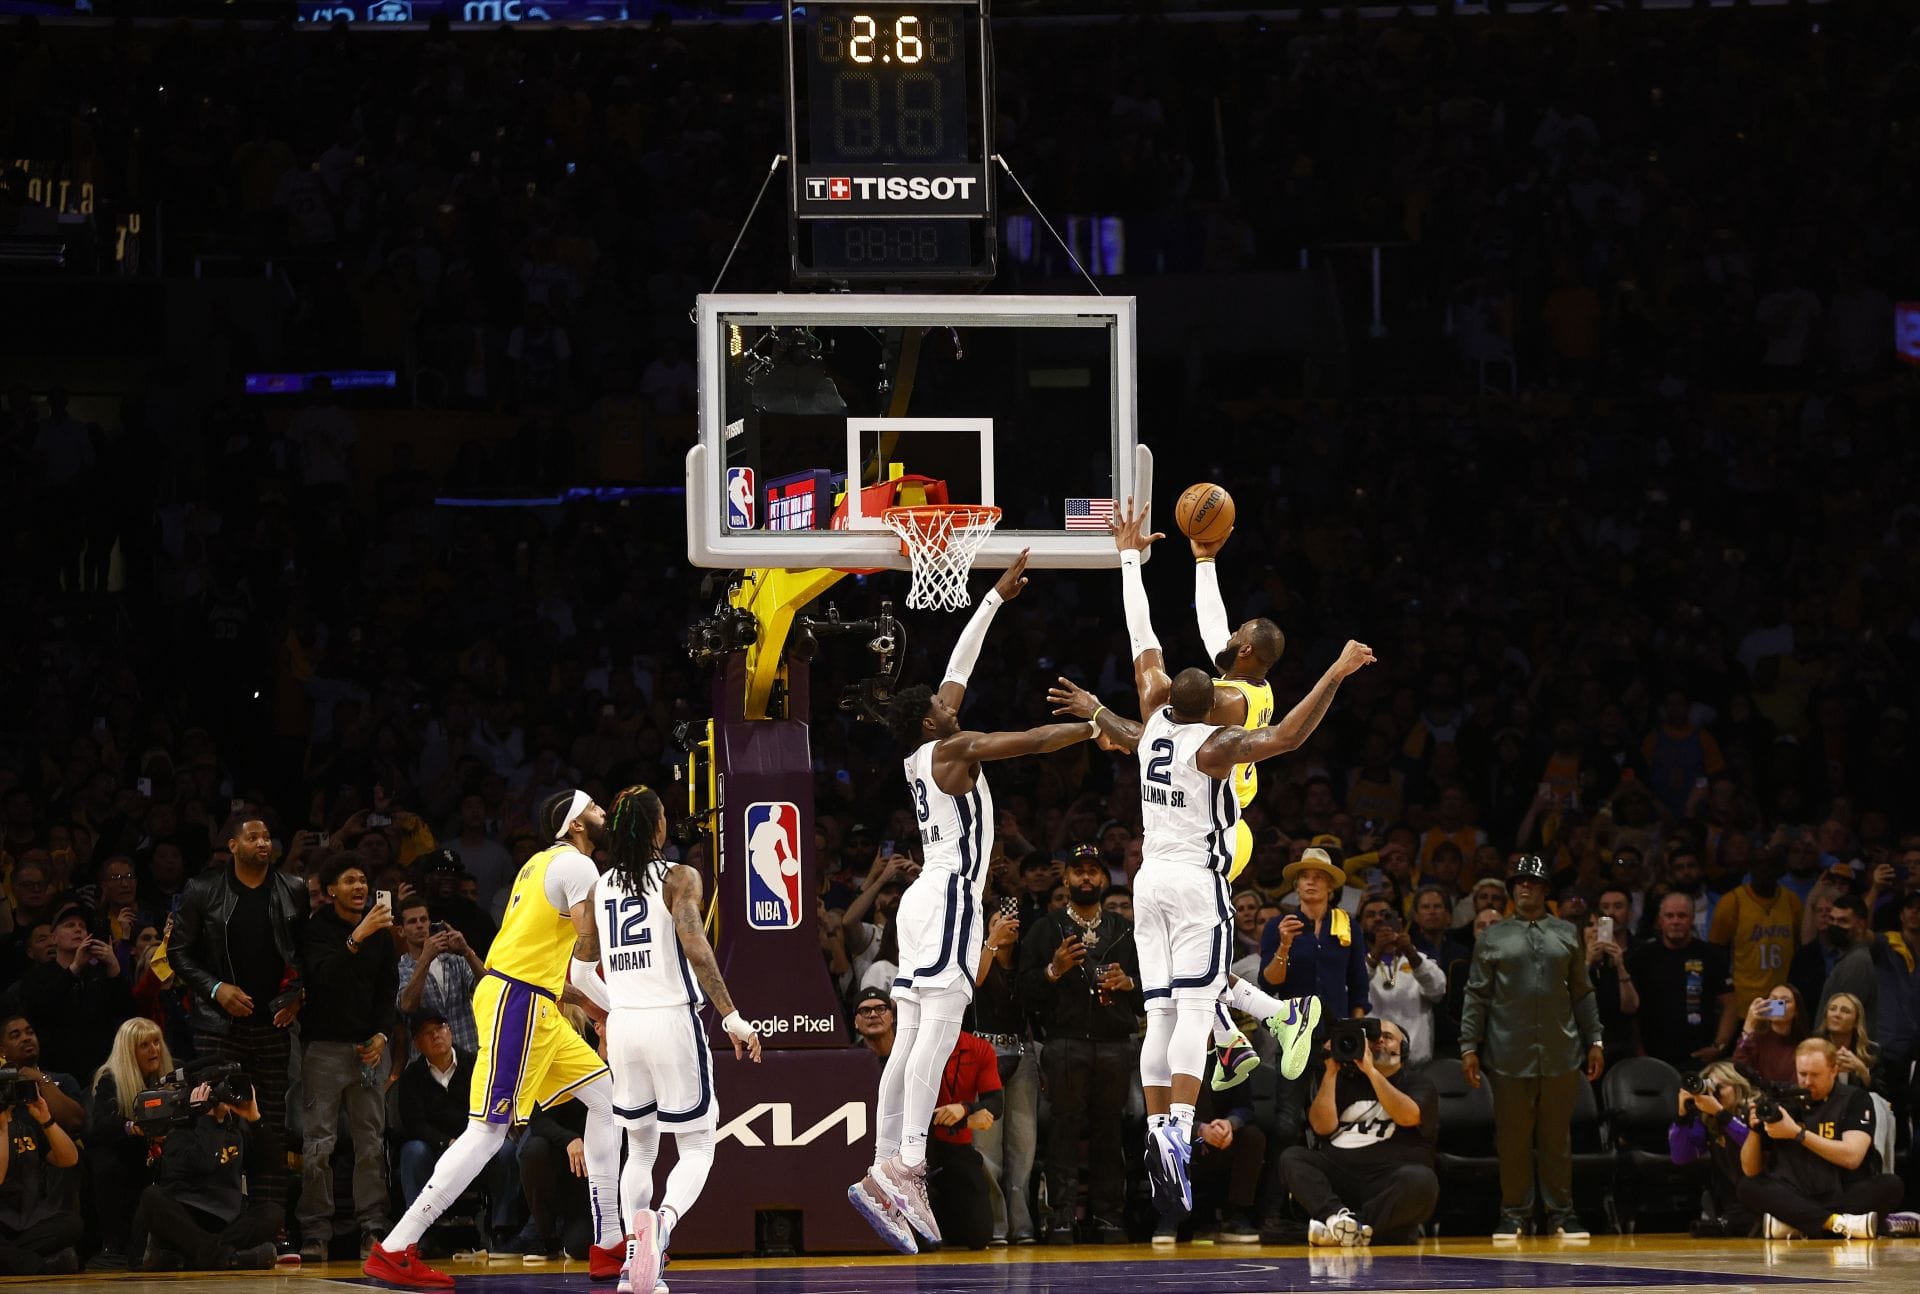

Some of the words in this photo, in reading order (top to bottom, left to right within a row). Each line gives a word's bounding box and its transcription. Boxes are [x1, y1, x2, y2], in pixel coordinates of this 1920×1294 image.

[850, 15, 922, 63] 2.6
[854, 177, 976, 200] TISSOT
[1146, 737, 1174, 786] 2
[1170, 790, 1187, 808] SR.
[930, 824, 944, 842] JR.
[604, 896, 652, 948] 12
[755, 901, 781, 921] NBA
[609, 949, 652, 973] MORANT
[1759, 943, 1783, 970] 16
[793, 1015, 834, 1032] Pixel
[1818, 1121, 1835, 1139] 15
